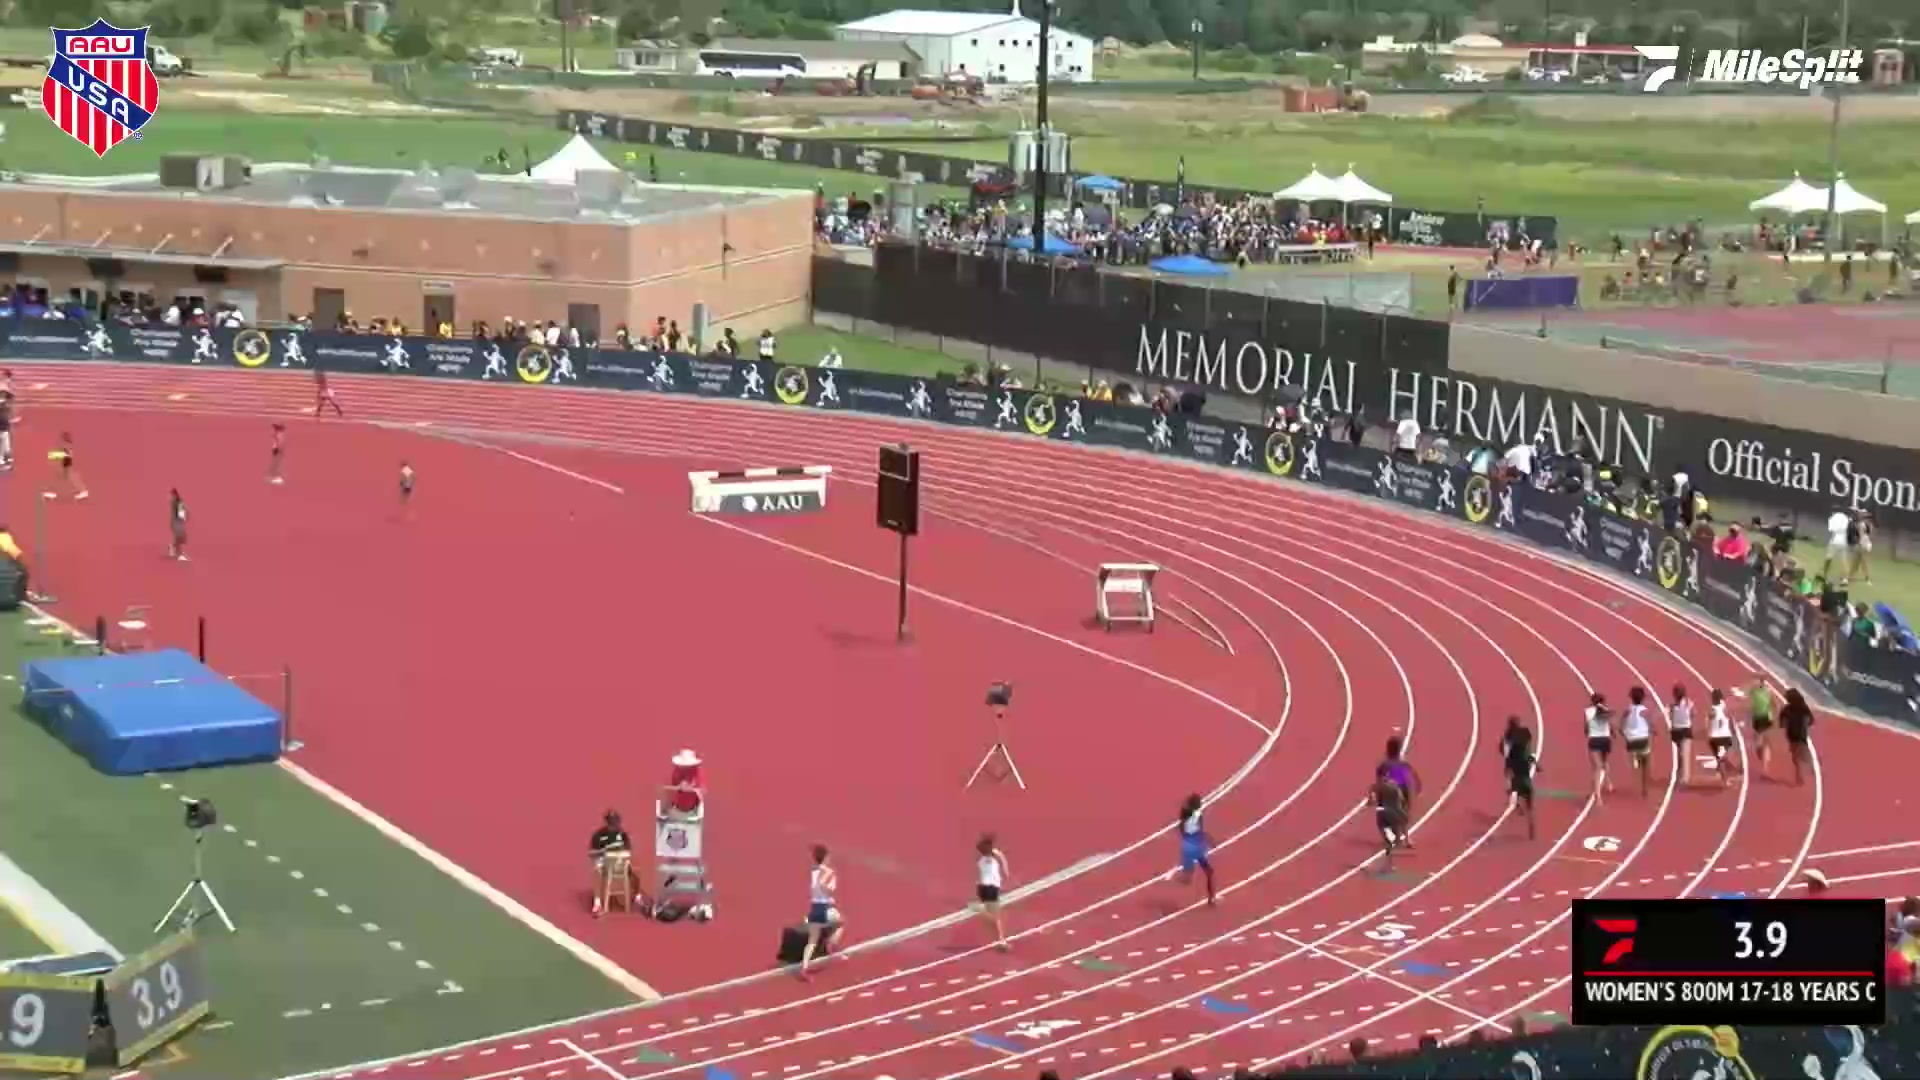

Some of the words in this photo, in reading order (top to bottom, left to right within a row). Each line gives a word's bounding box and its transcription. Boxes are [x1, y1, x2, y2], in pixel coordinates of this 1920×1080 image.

[762, 495, 803, 512] AAU
[1708, 438, 1821, 493] Official
[1829, 458, 1920, 513] Spon
[131, 961, 182, 1030] 3.9
